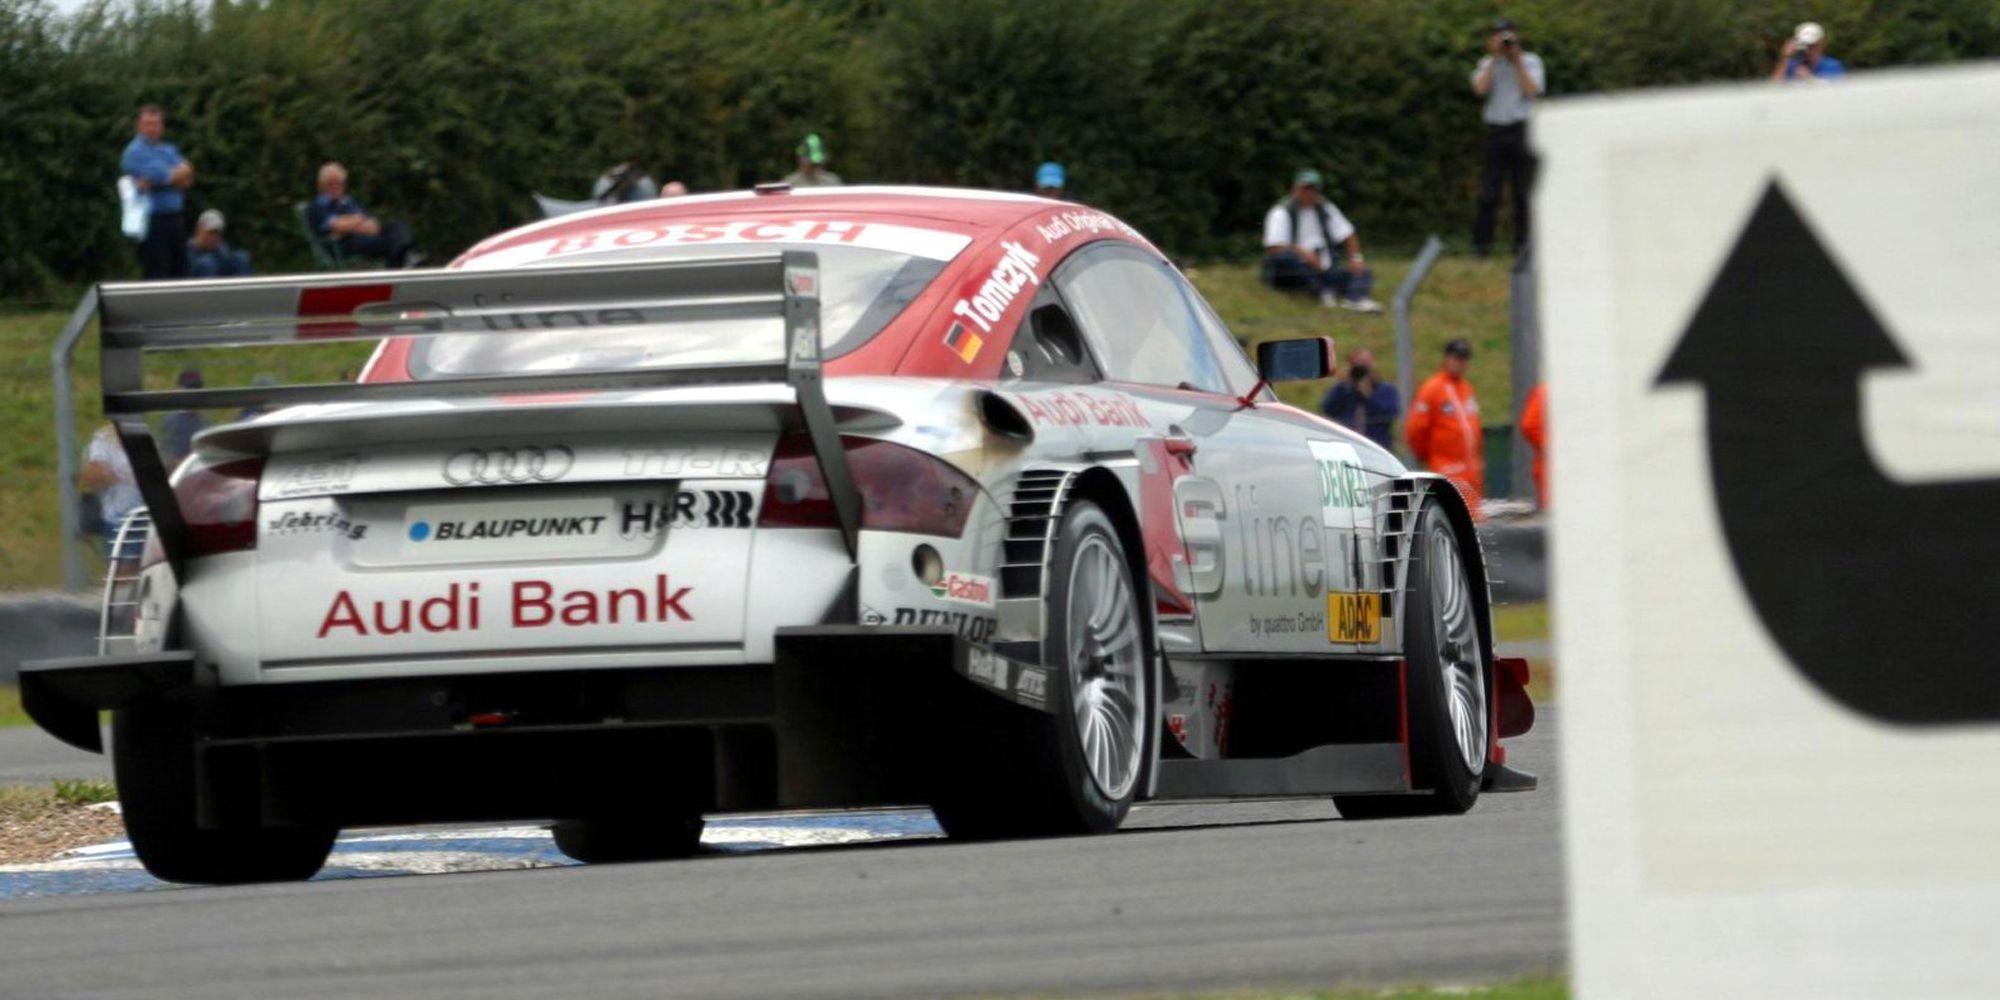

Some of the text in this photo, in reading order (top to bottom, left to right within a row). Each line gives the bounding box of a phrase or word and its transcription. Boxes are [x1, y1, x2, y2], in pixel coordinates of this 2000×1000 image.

[546, 220, 866, 255] BOSCH
[1035, 214, 1073, 244] Audi
[953, 241, 1041, 333] Tomczyk
[1016, 390, 1152, 428] Audi Bank
[269, 511, 369, 540] Sebring
[434, 515, 607, 541] BLAUPUNKT
[1171, 475, 1325, 601] S line
[949, 573, 992, 602] Castrol
[316, 573, 695, 639] Audi Bank
[1337, 595, 1373, 640] ADAC
[1250, 612, 1325, 637] by quattro GmbH
